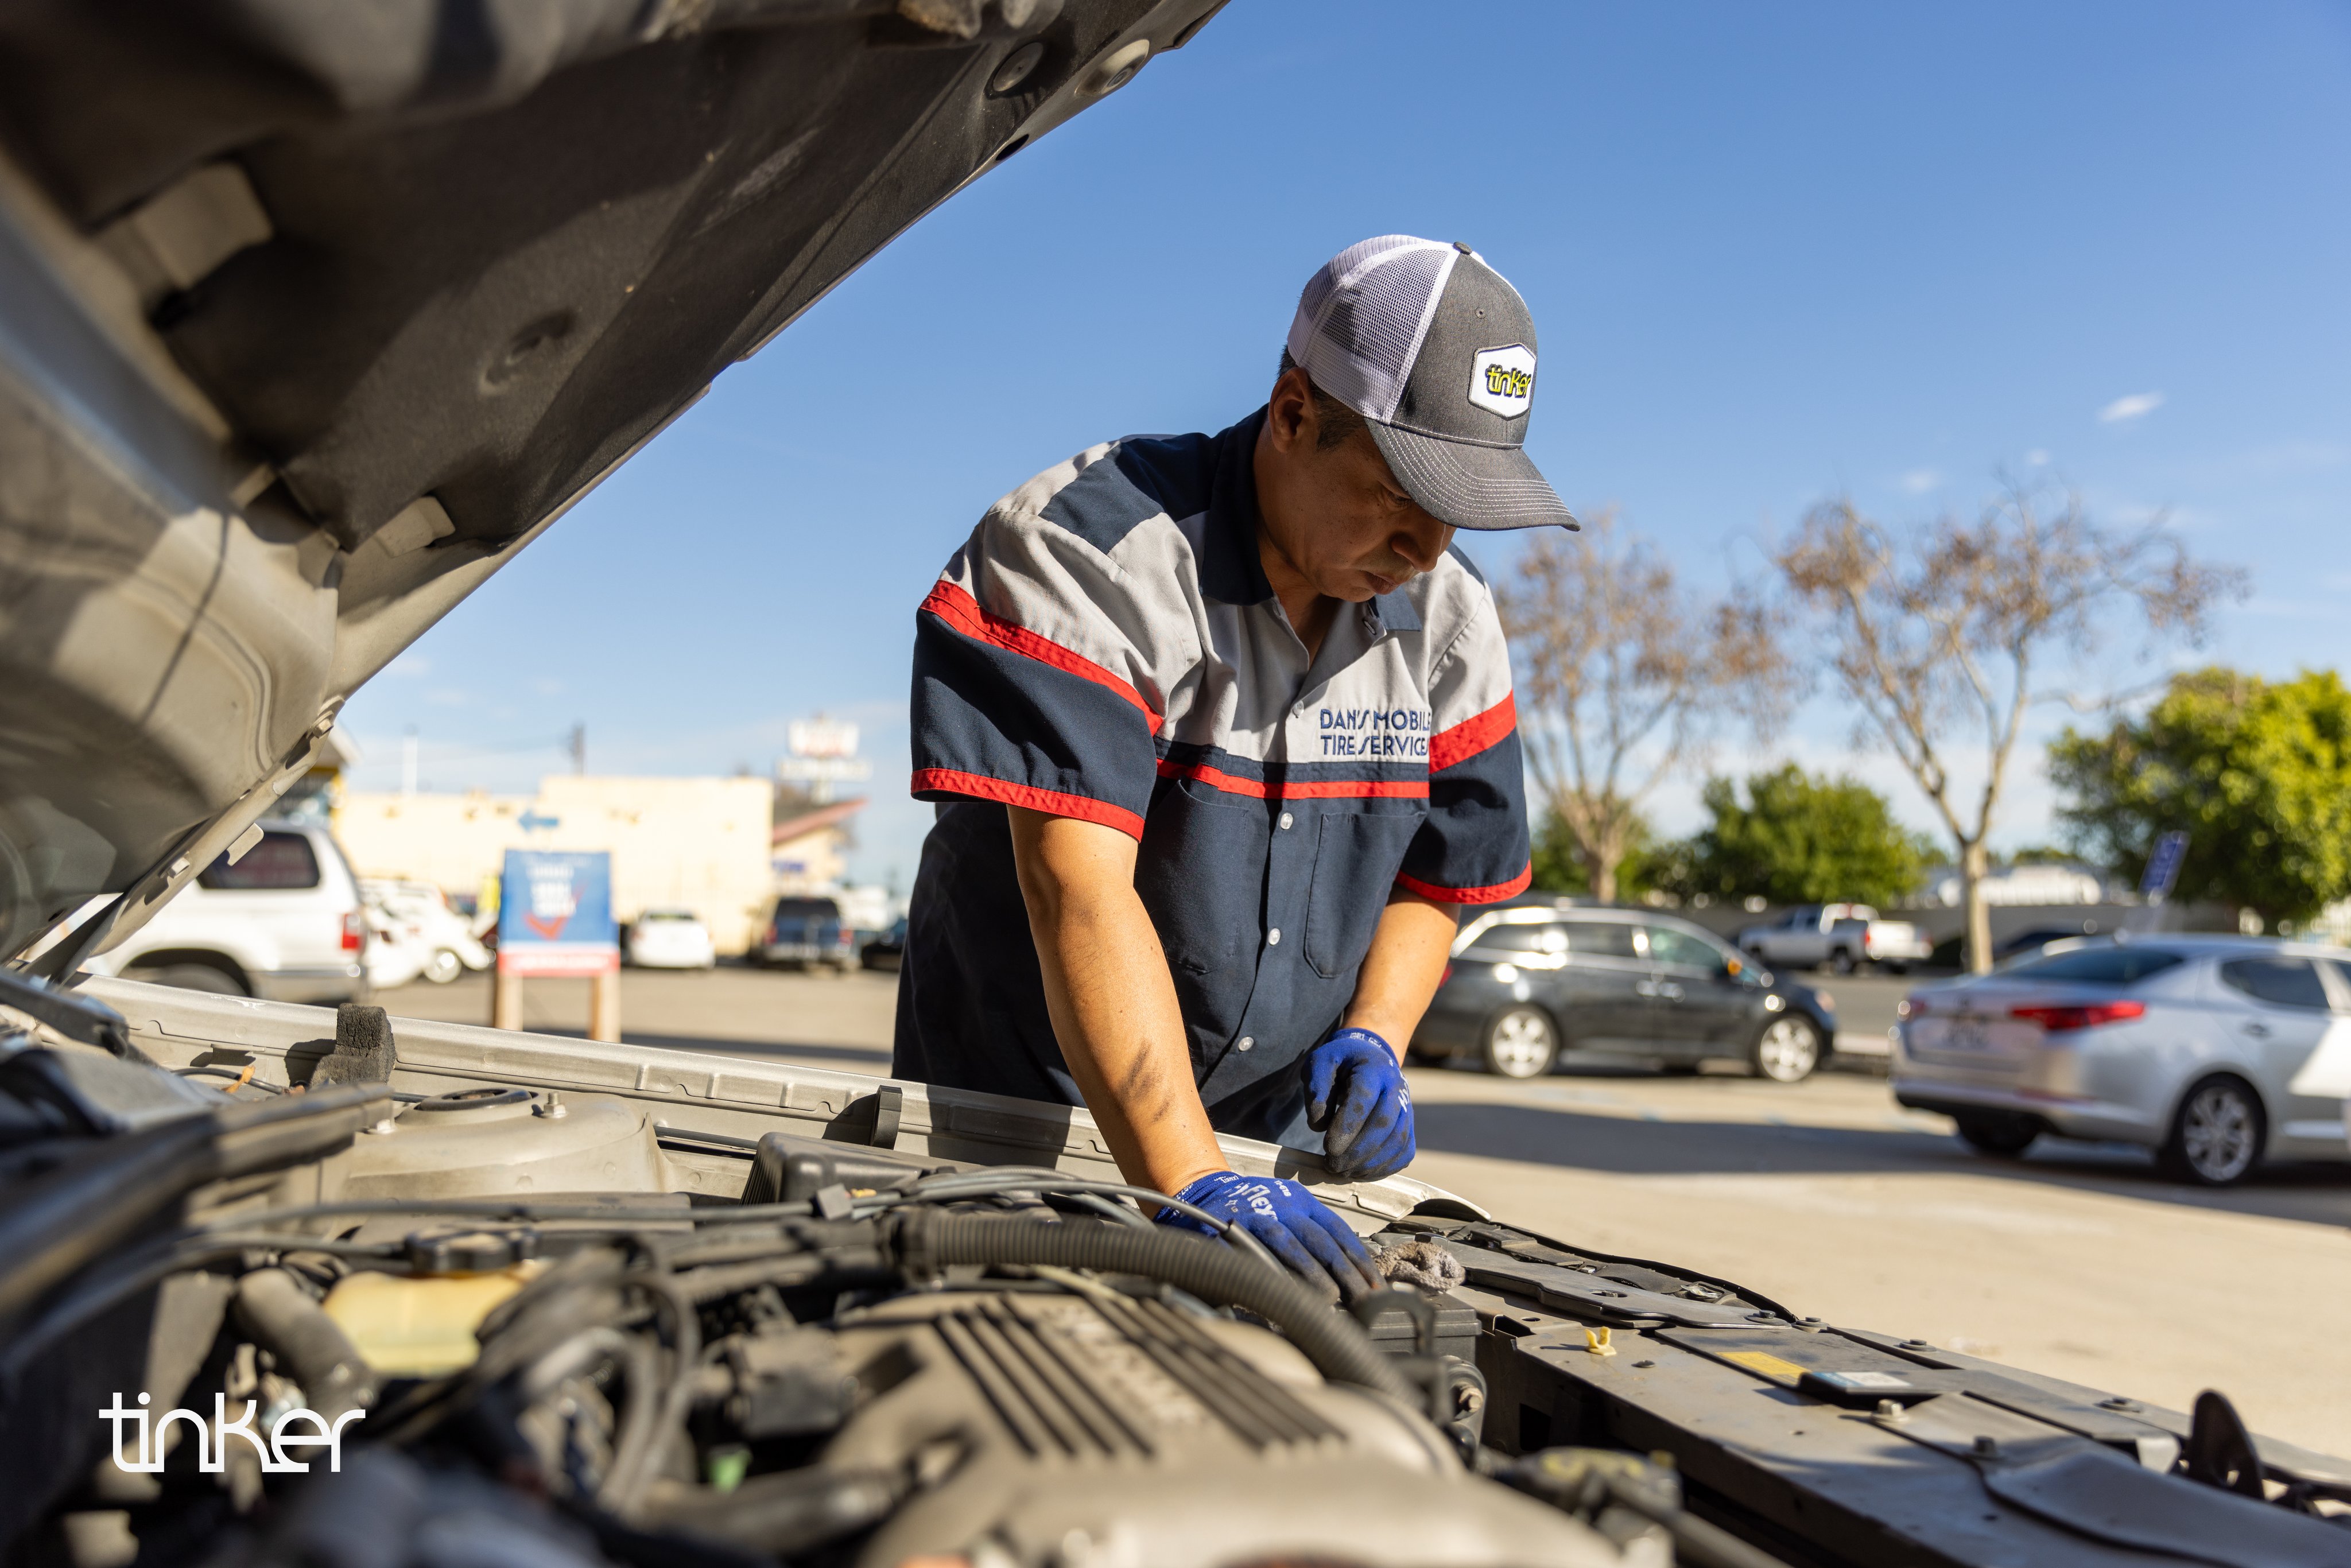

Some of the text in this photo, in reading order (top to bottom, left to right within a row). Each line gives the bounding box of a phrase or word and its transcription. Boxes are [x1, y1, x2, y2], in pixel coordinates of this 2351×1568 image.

[1485, 364, 1531, 398] tinker
[1321, 709, 1369, 729] DAN'S
[1321, 735, 1355, 755] TIRE
